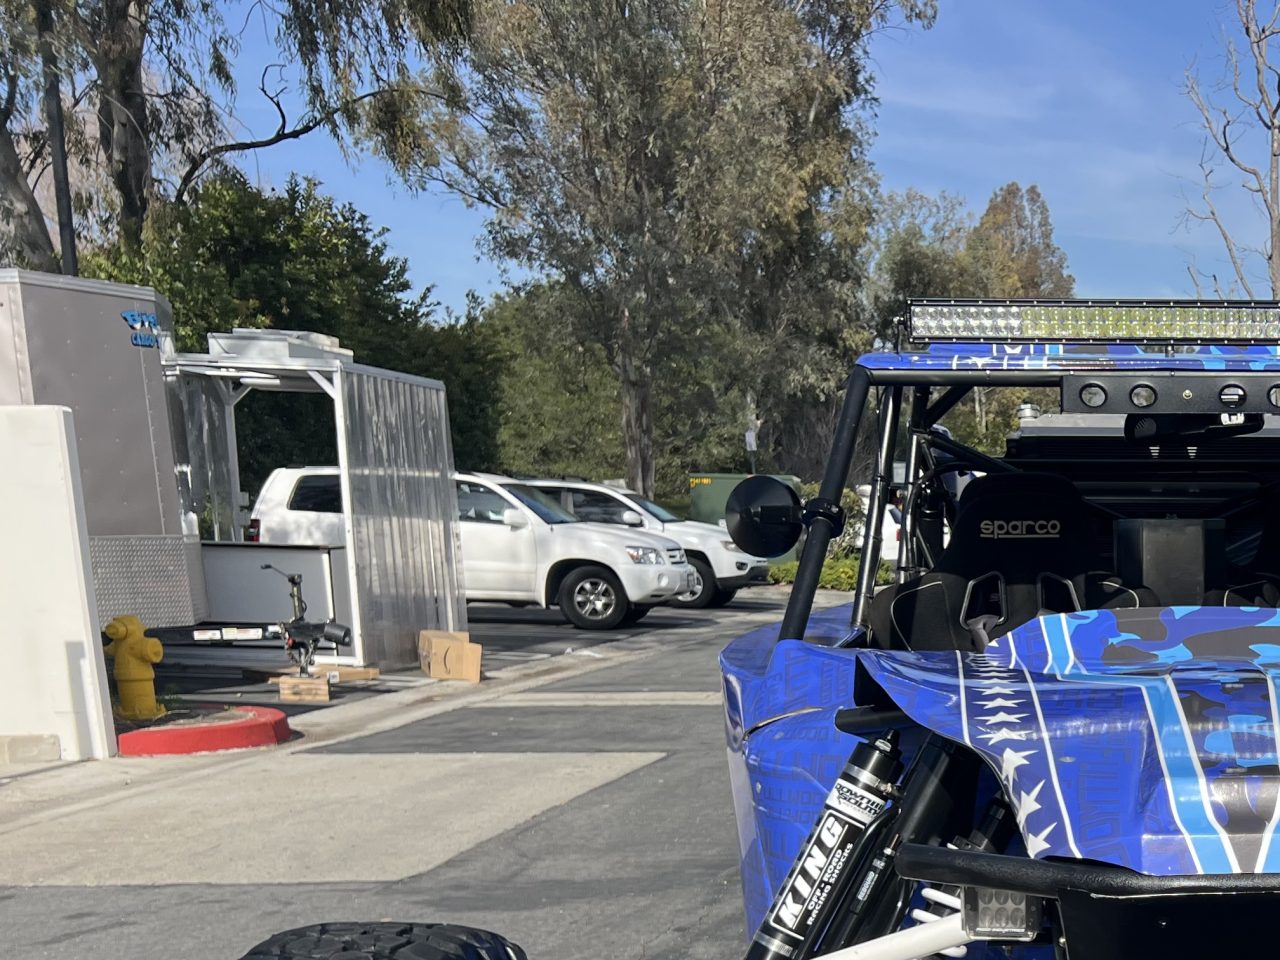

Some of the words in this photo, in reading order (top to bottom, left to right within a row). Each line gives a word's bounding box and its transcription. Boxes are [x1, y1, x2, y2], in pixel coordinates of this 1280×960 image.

[980, 519, 1061, 539] sparco
[779, 816, 843, 929] KING
[806, 884, 830, 926] RACING
[828, 843, 853, 885] SHOCKS
[857, 870, 875, 901] REBOUND
